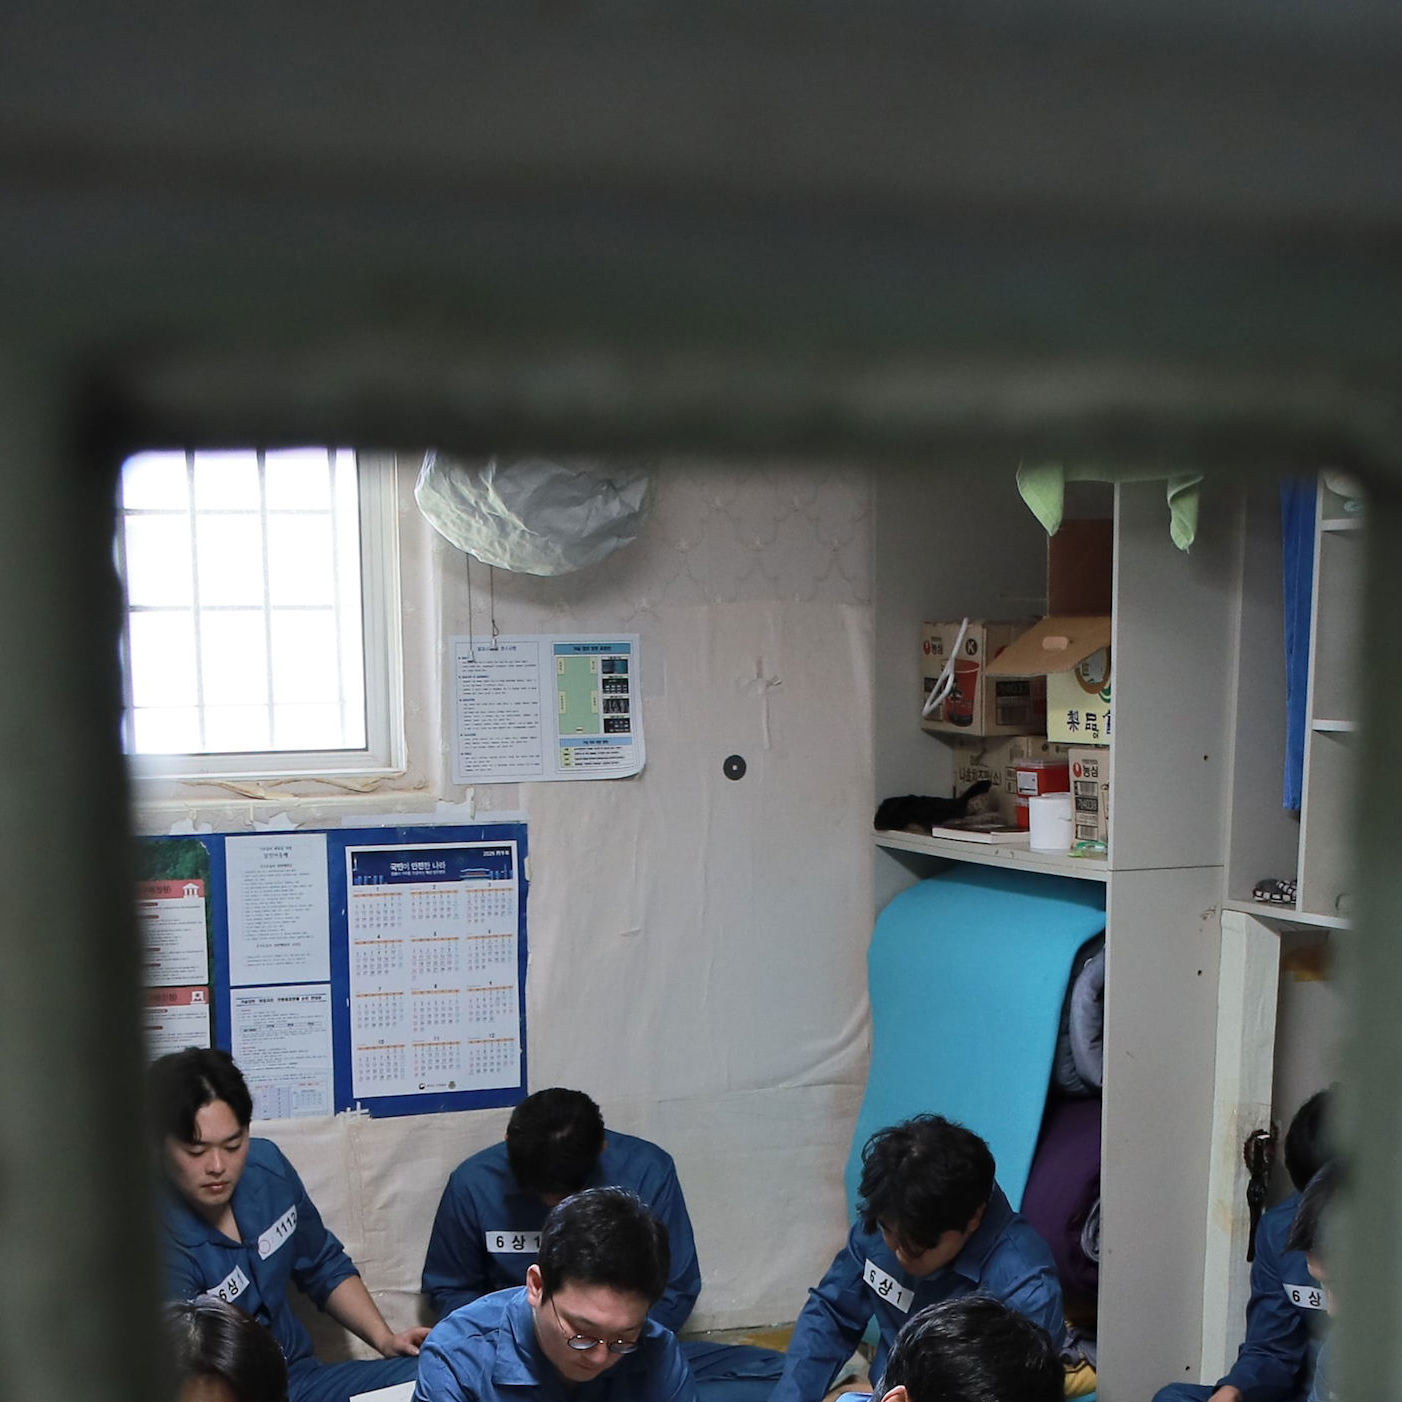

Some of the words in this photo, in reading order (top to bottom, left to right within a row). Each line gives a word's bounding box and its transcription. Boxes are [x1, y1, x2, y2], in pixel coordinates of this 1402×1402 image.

[1082, 765, 1098, 778] 농심
[275, 1211, 297, 1238] 1112
[512, 1234, 527, 1250] 상
[227, 1279, 239, 1296] 상
[879, 1277, 893, 1297] 상
[1308, 1290, 1322, 1307] 상
